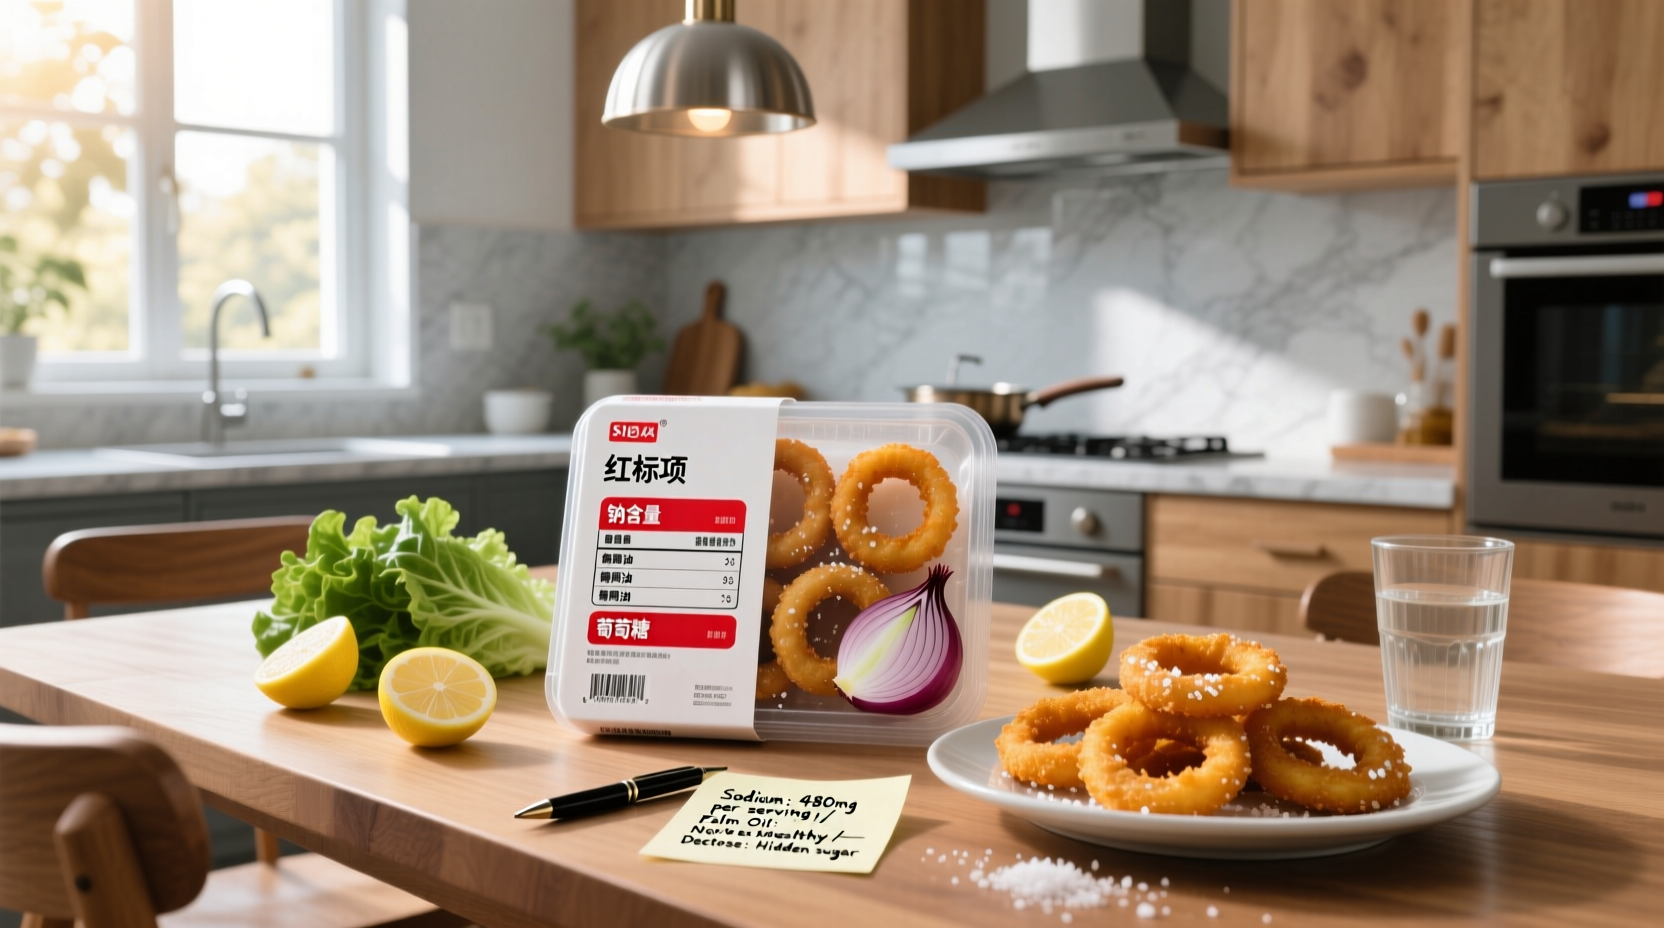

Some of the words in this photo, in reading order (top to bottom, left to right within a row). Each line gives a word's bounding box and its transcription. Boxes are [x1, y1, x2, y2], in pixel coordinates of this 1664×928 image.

[603, 454, 689, 485] 红标项
[607, 503, 661, 525] 钠含量
[710, 803, 741, 815] per
[799, 794, 857, 815] 480mg
[756, 840, 809, 854] Hidden
[816, 847, 860, 861] sugar
